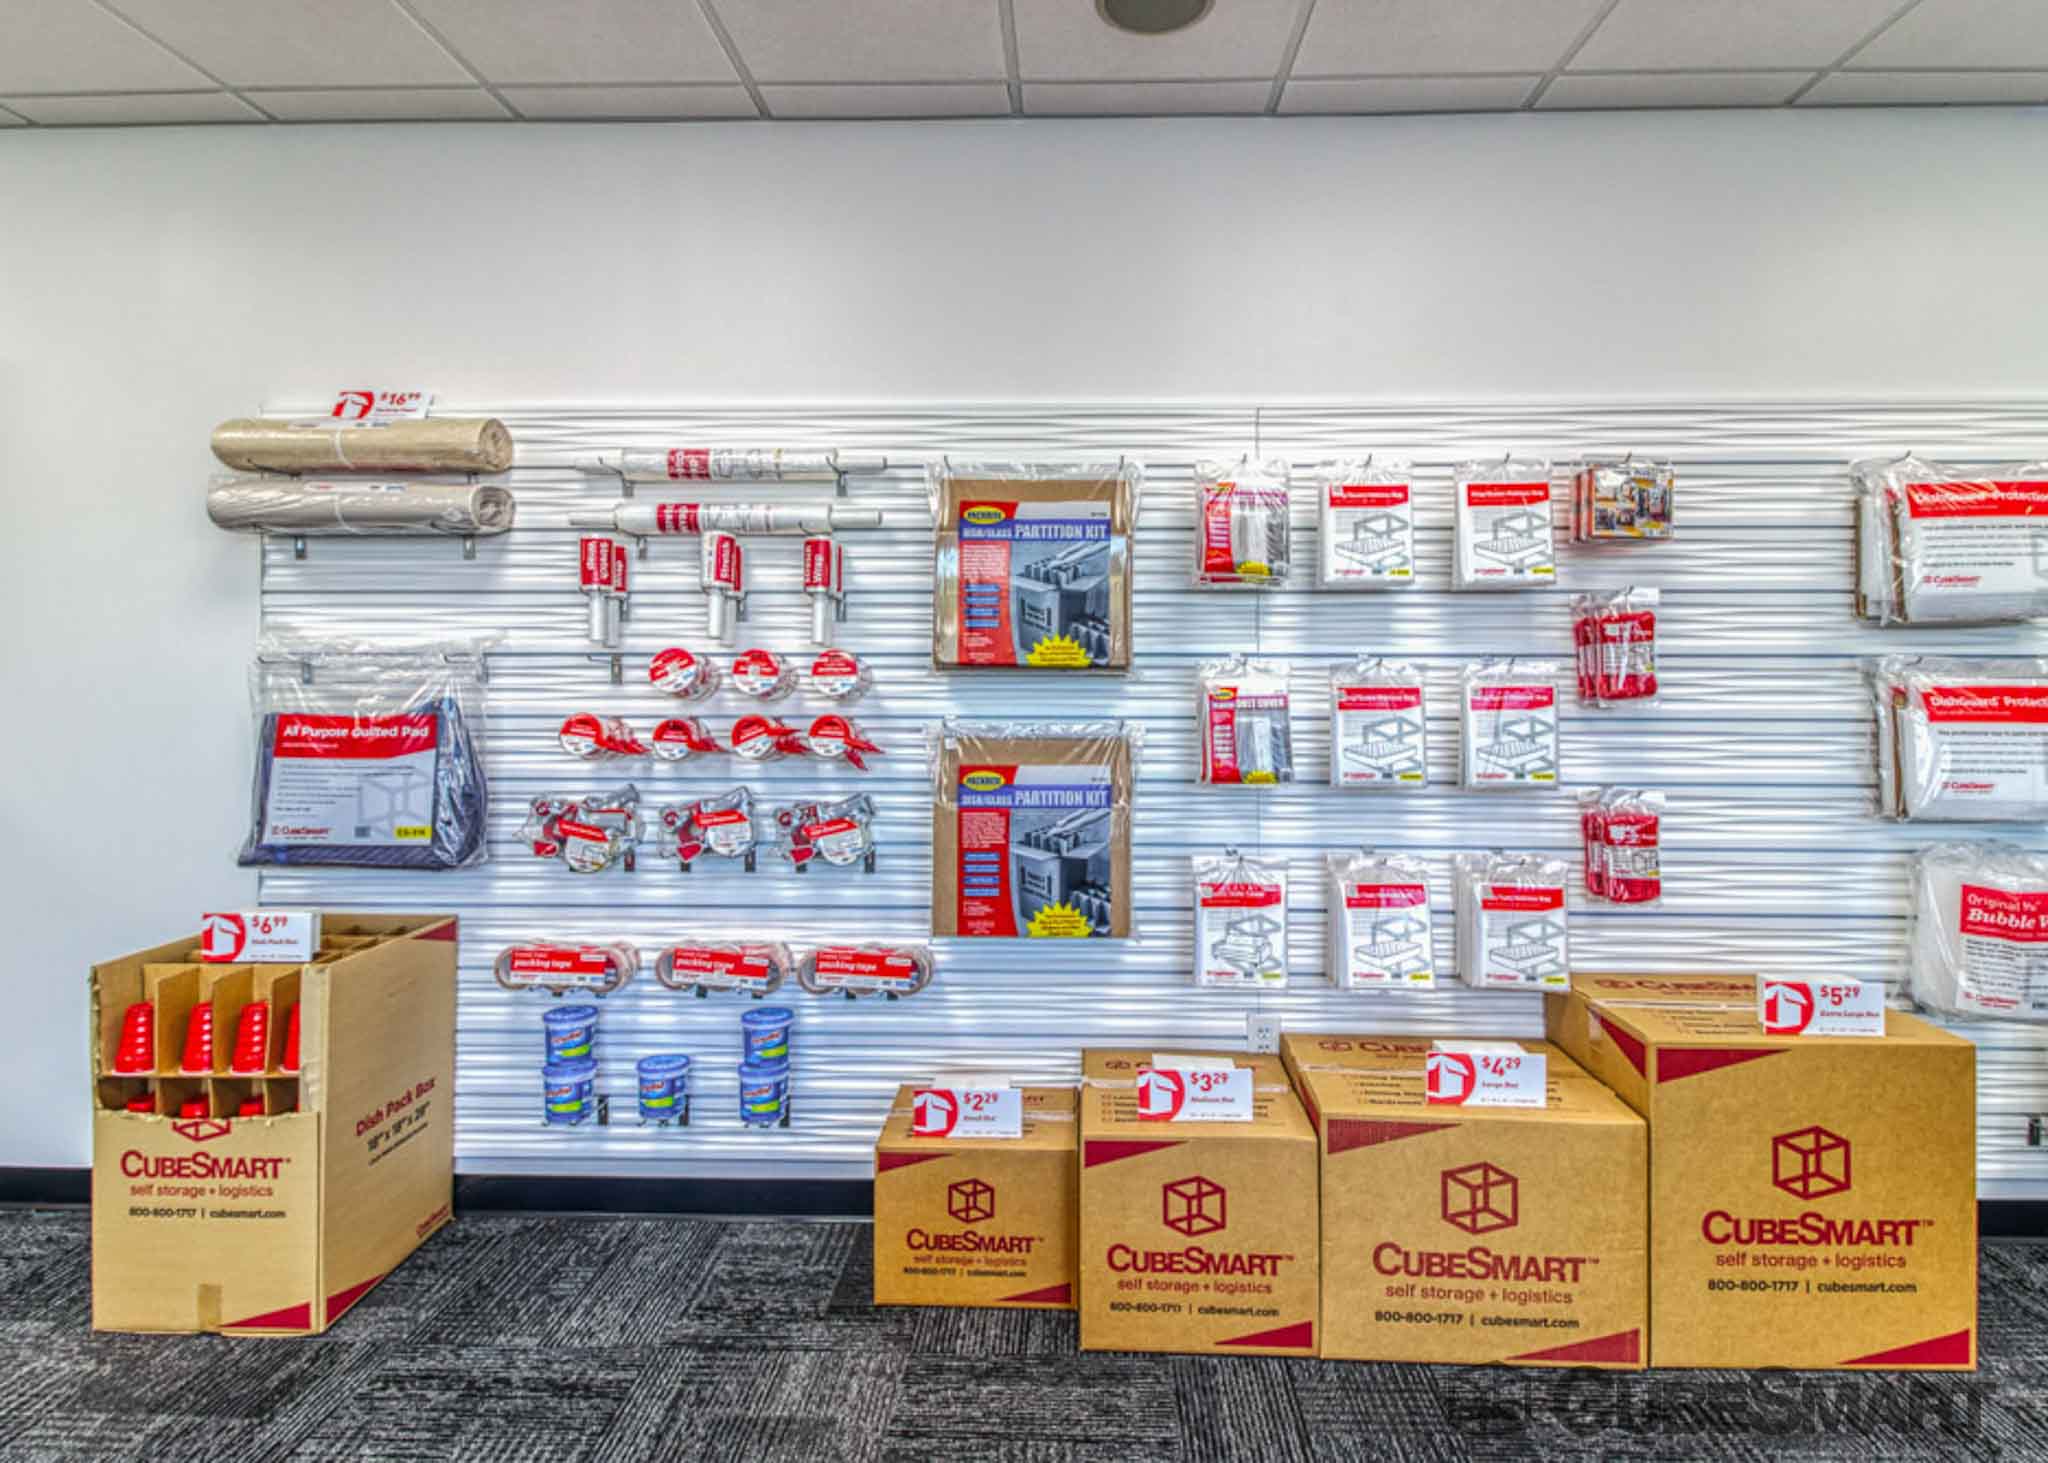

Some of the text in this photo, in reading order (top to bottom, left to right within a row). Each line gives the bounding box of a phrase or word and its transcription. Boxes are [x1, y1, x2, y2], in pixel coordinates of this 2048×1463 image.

[1014, 524, 1082, 540] PARTITION
[1085, 524, 1107, 539] KIT
[351, 726, 397, 738] Quilted
[402, 726, 429, 737] Pad
[1014, 790, 1083, 806] PARTITION
[1086, 790, 1108, 806] KIT
[1967, 893, 2020, 912] Original
[1967, 908, 2036, 929] Bubble
[513, 960, 550, 968] packing
[386, 1087, 413, 1119] Pack
[120, 1150, 284, 1179] CUBESMART
[130, 1184, 153, 1197] self
[157, 1185, 206, 1199] storage
[219, 1184, 274, 1199] logistics
[209, 1208, 287, 1219] cubesmart.com
[1701, 1210, 1921, 1247] CUBESMART
[906, 1228, 1034, 1253] CUBESMART
[913, 1255, 932, 1263] self
[935, 1256, 973, 1267] storage
[984, 1256, 1027, 1267] logistics
[1106, 1243, 1282, 1276] CUBESMART
[1372, 1242, 1587, 1283] CUBESMART
[1716, 1253, 1747, 1268] self
[1751, 1255, 1818, 1271] storage
[1835, 1255, 1906, 1272] logistics
[1117, 1278, 1143, 1291] self
[1146, 1279, 1199, 1294] storage
[1213, 1281, 1273, 1295] logistics
[1385, 1285, 1416, 1300] self
[1420, 1286, 1485, 1304] storage
[1502, 1288, 1573, 1306] logistics
[1707, 1279, 1918, 1295] 800-800-1717 cubesmart.com
[1198, 1305, 1280, 1317] cubesmart.com
[1374, 1310, 1579, 1329] 800-800-1717 cubesmart.com
